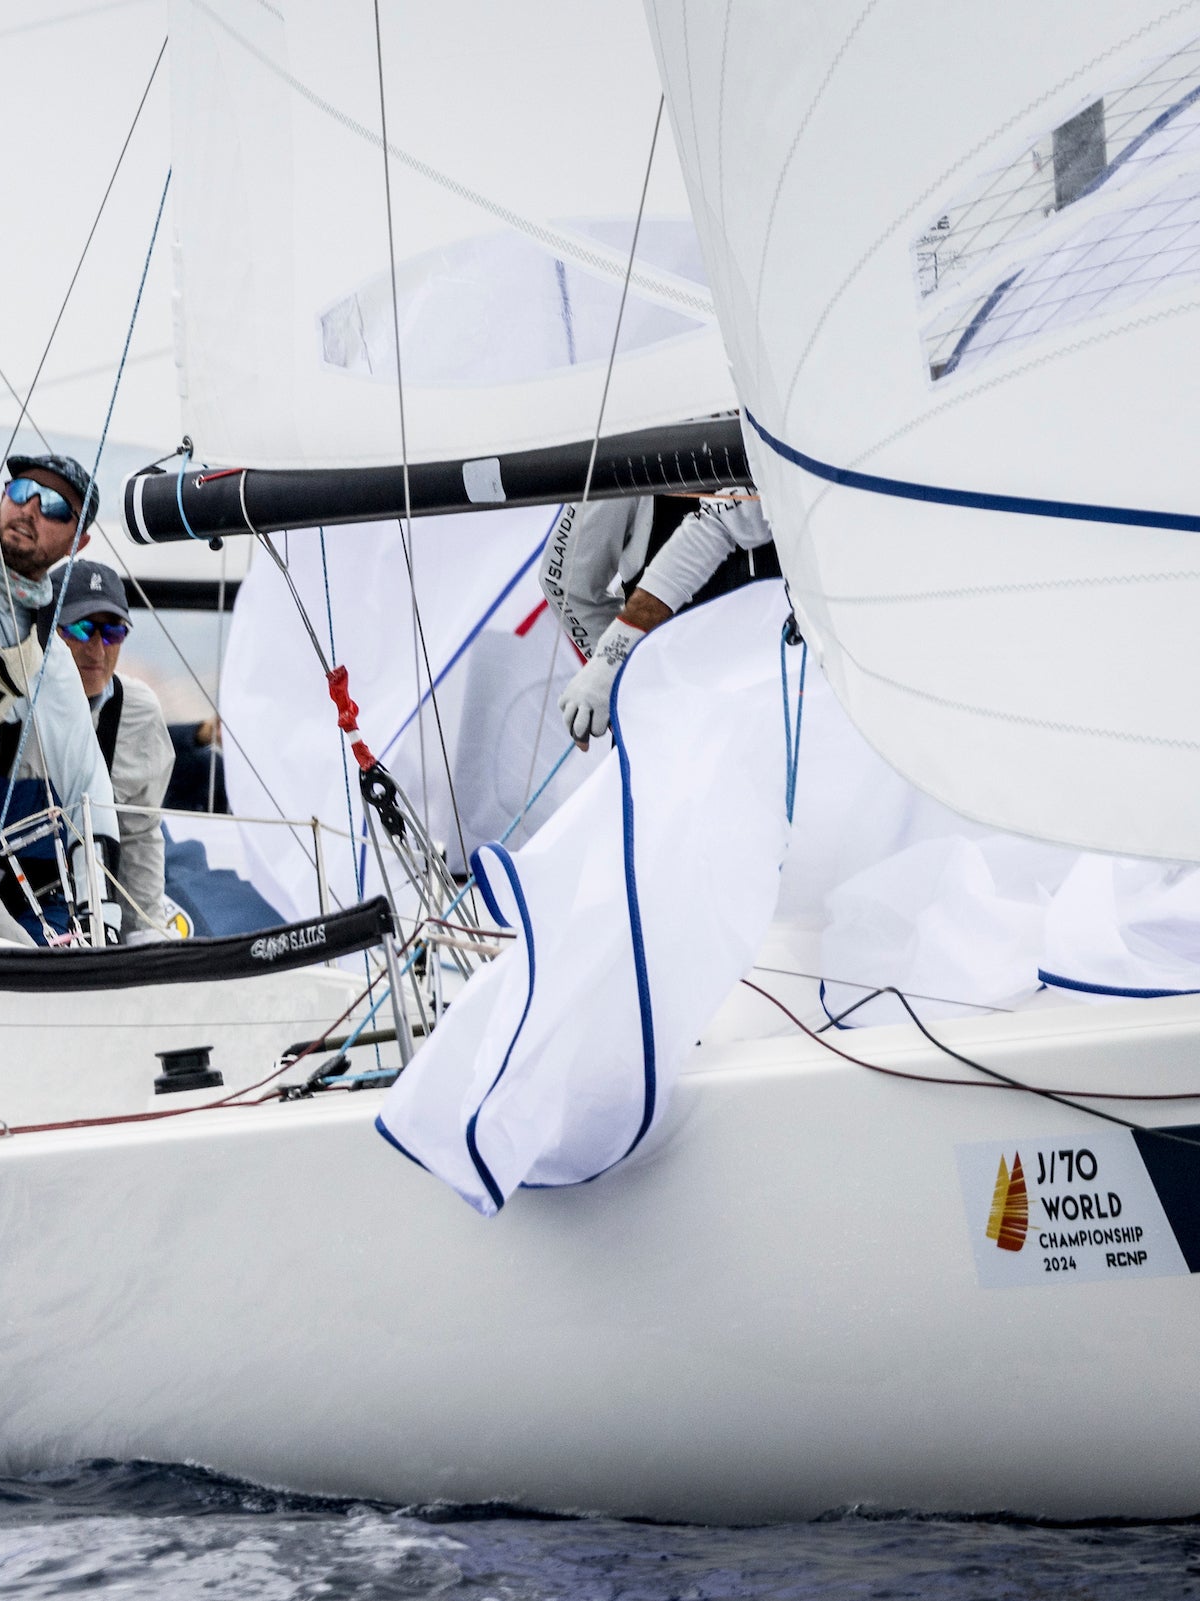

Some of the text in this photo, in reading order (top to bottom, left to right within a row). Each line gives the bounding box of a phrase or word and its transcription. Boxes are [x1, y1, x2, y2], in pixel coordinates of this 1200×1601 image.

[545, 503, 576, 586] ISLANDS
[1037, 1148, 1098, 1185] J/70
[1041, 1192, 1122, 1221] WORLD
[1039, 1226, 1144, 1249] CHAMPIONSHIP
[1043, 1250, 1148, 1272] 2024 RCNP
